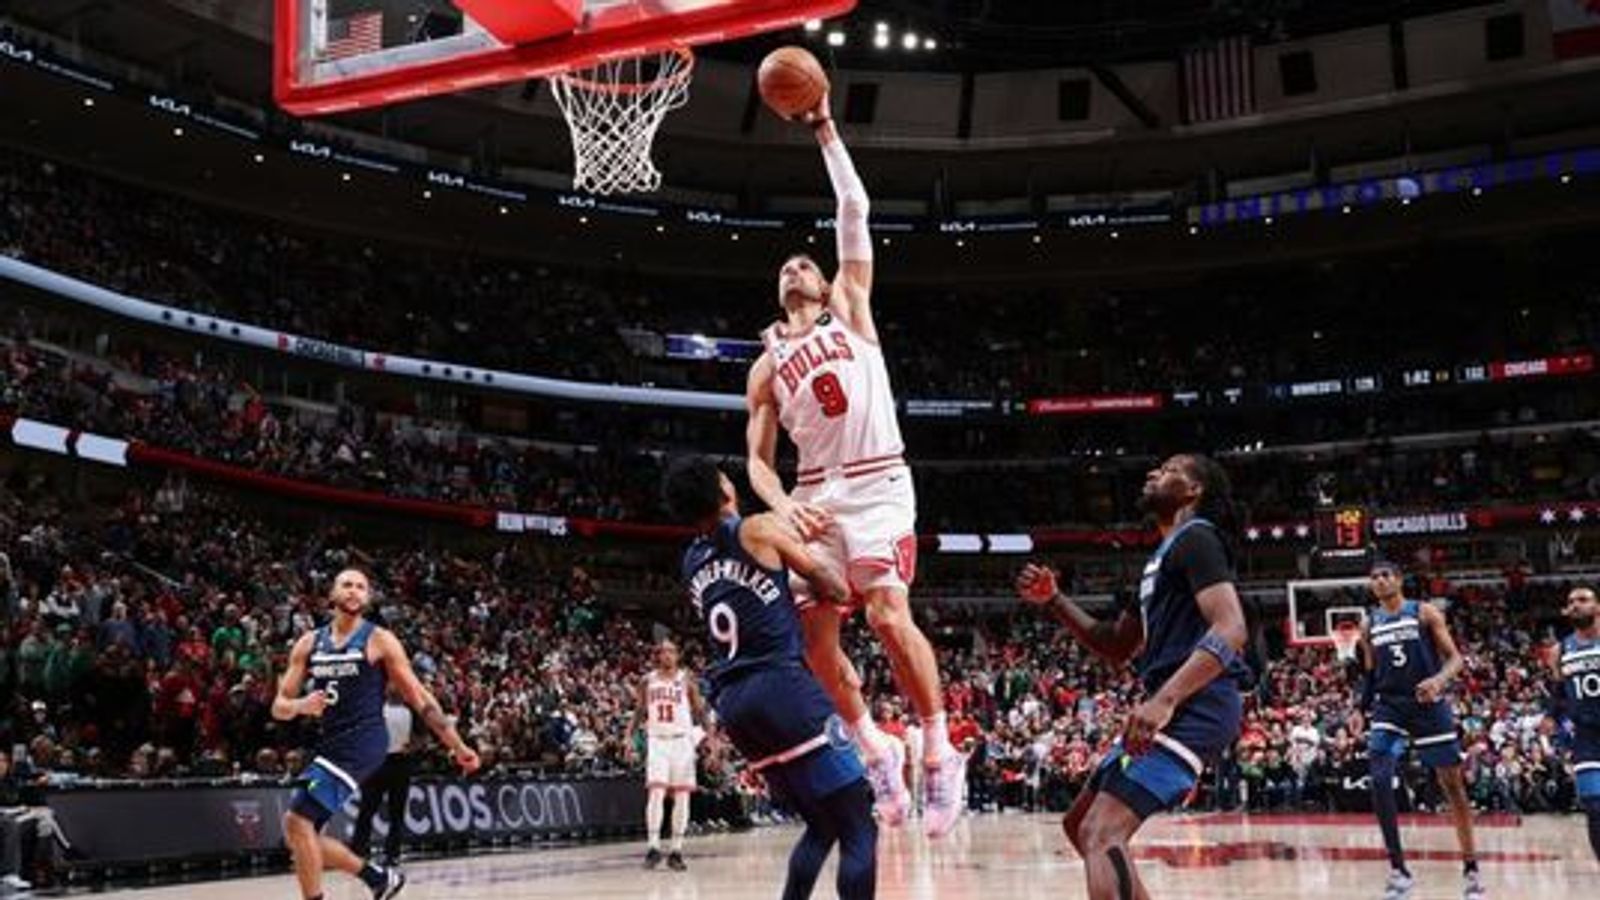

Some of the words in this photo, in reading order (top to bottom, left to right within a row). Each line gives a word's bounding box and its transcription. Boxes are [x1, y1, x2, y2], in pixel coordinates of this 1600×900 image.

[778, 331, 855, 398] BULLS
[812, 371, 848, 419] 9
[1373, 516, 1425, 535] CHICAGO
[1428, 512, 1468, 532] BULLS
[709, 602, 738, 661] 9
[1389, 644, 1407, 667] 3
[326, 681, 338, 705] 5
[1573, 673, 1600, 700] 10
